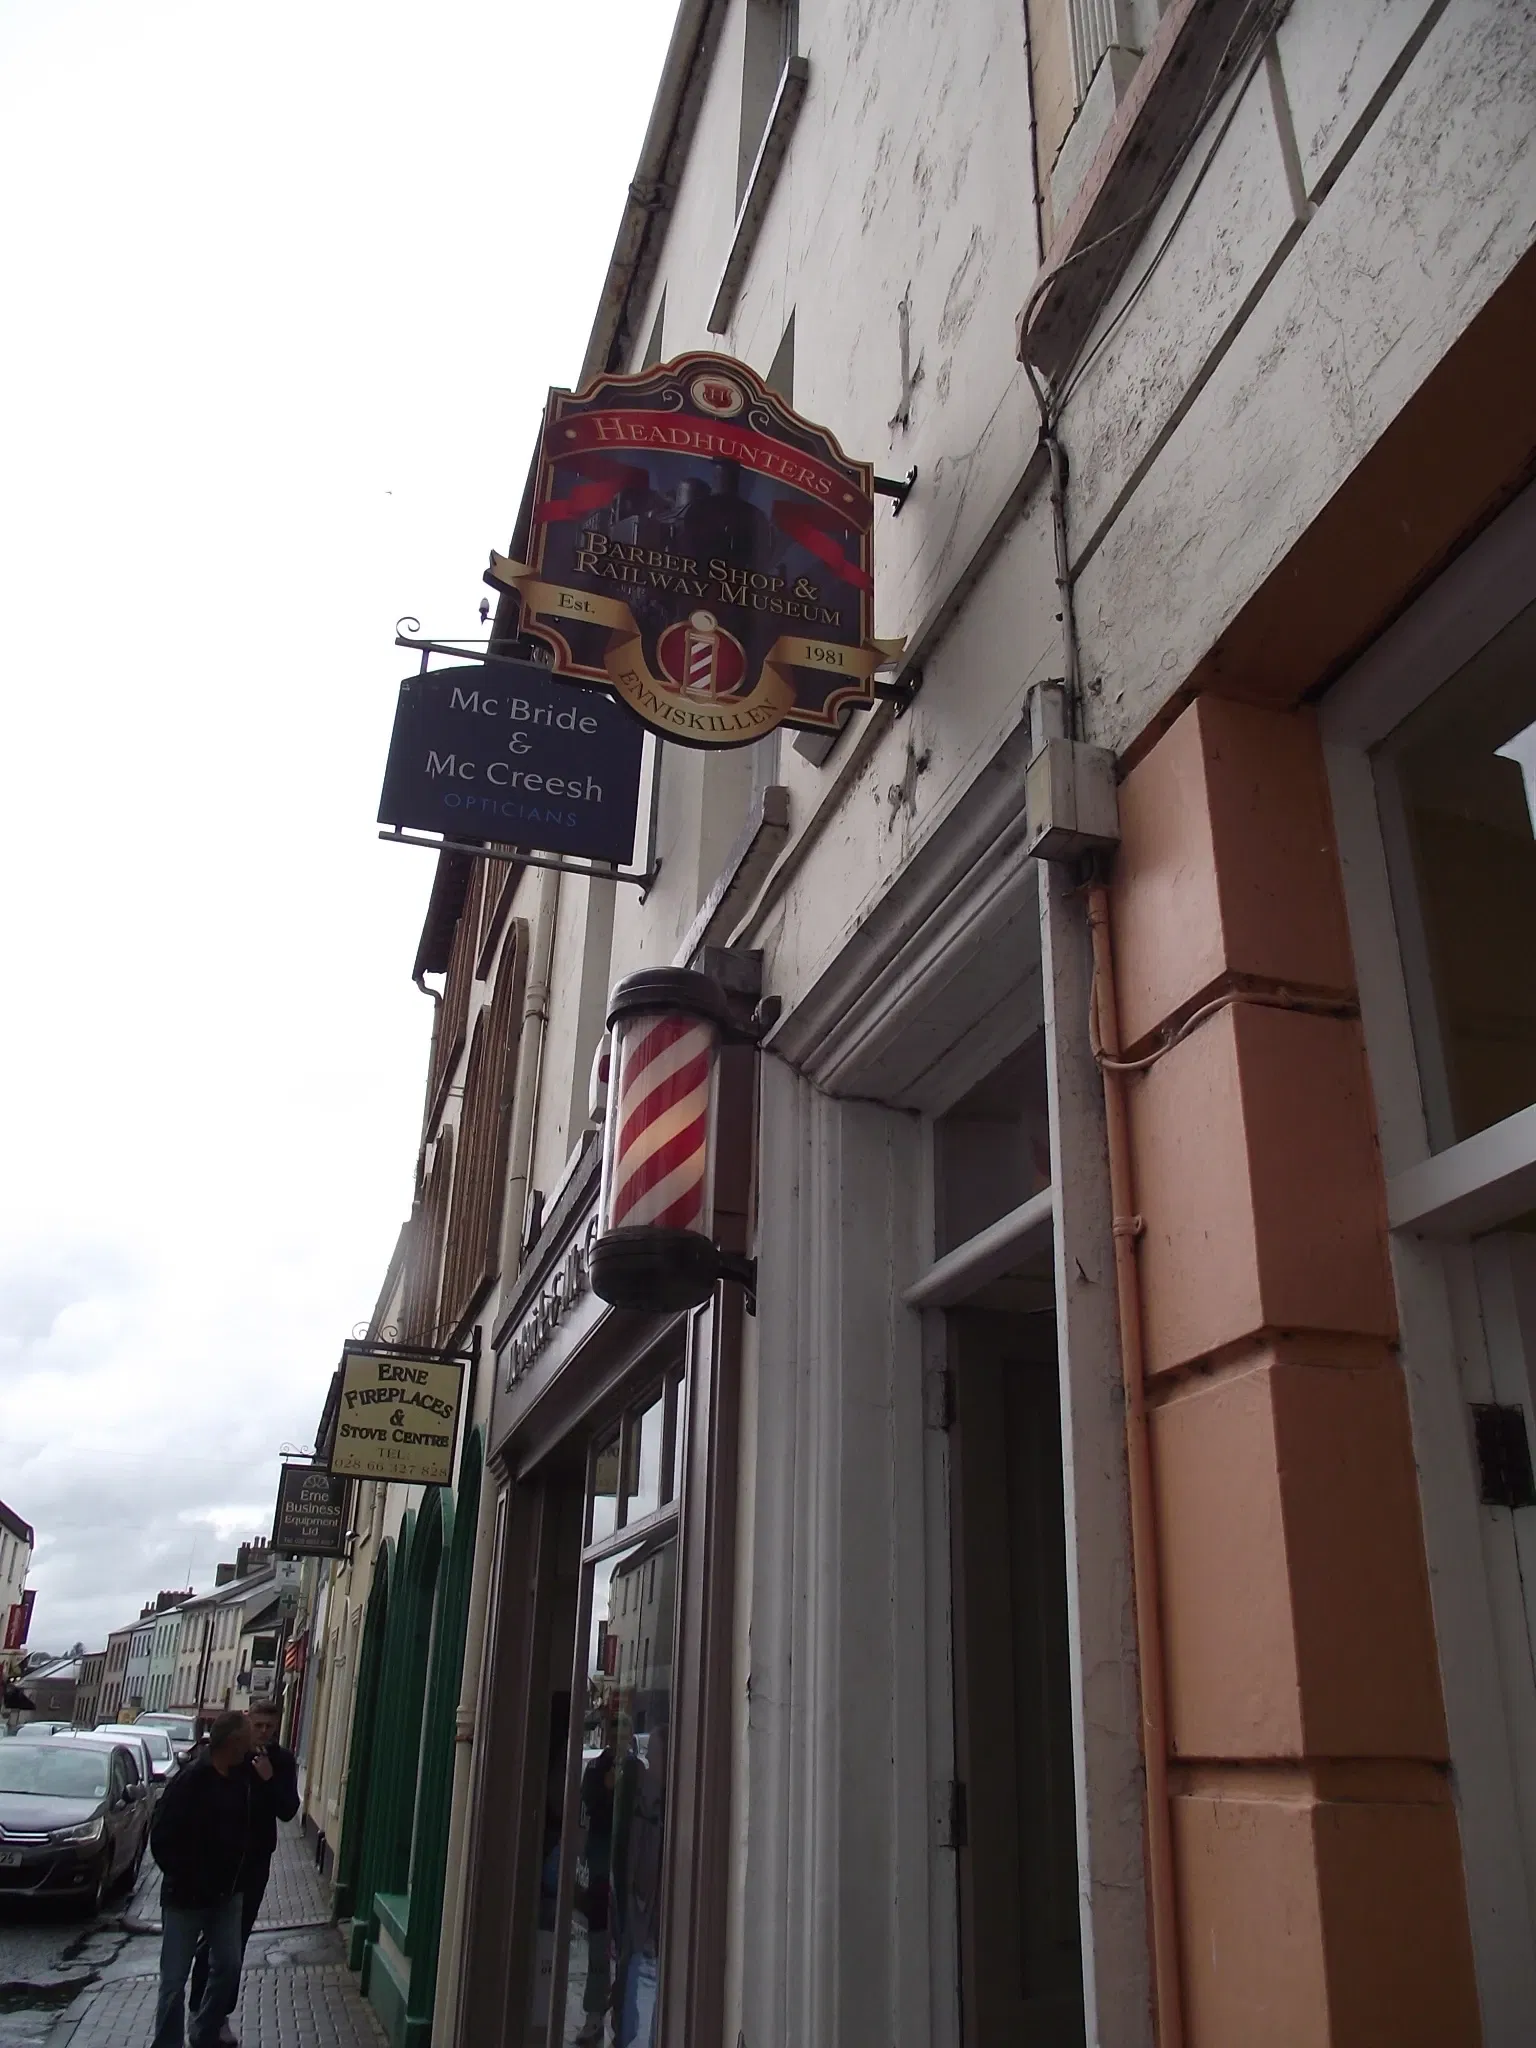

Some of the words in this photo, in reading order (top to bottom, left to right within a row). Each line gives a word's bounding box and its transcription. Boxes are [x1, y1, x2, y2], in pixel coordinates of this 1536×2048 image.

[593, 417, 832, 495] HEADHUNTERS
[584, 531, 697, 575] BARBER
[709, 558, 784, 592] SHOP
[795, 578, 818, 600] &
[576, 552, 709, 597] RAILWAY
[718, 582, 841, 626] MUSEUM
[558, 592, 595, 614] Est.
[804, 645, 845, 666] 1981
[449, 687, 498, 716] Mc
[510, 698, 597, 734] Bride
[618, 669, 778, 731] ENNISKILLEN
[509, 732, 532, 754] &
[425, 751, 475, 780] Mc
[486, 762, 602, 803] Creesh
[444, 793, 577, 827] OPTICIANS
[378, 1364, 428, 1385] ERNE
[344, 1388, 453, 1419] FIREPLACES
[389, 1409, 405, 1427] &
[340, 1424, 387, 1441] STOVE
[392, 1429, 449, 1447] CENTRE
[334, 1459, 361, 1469] 028
[367, 1461, 384, 1472] 66
[421, 1465, 447, 1477] 828
[301, 1490, 329, 1502] Erne
[285, 1502, 340, 1515] Business
[284, 1515, 338, 1526] Equipment
